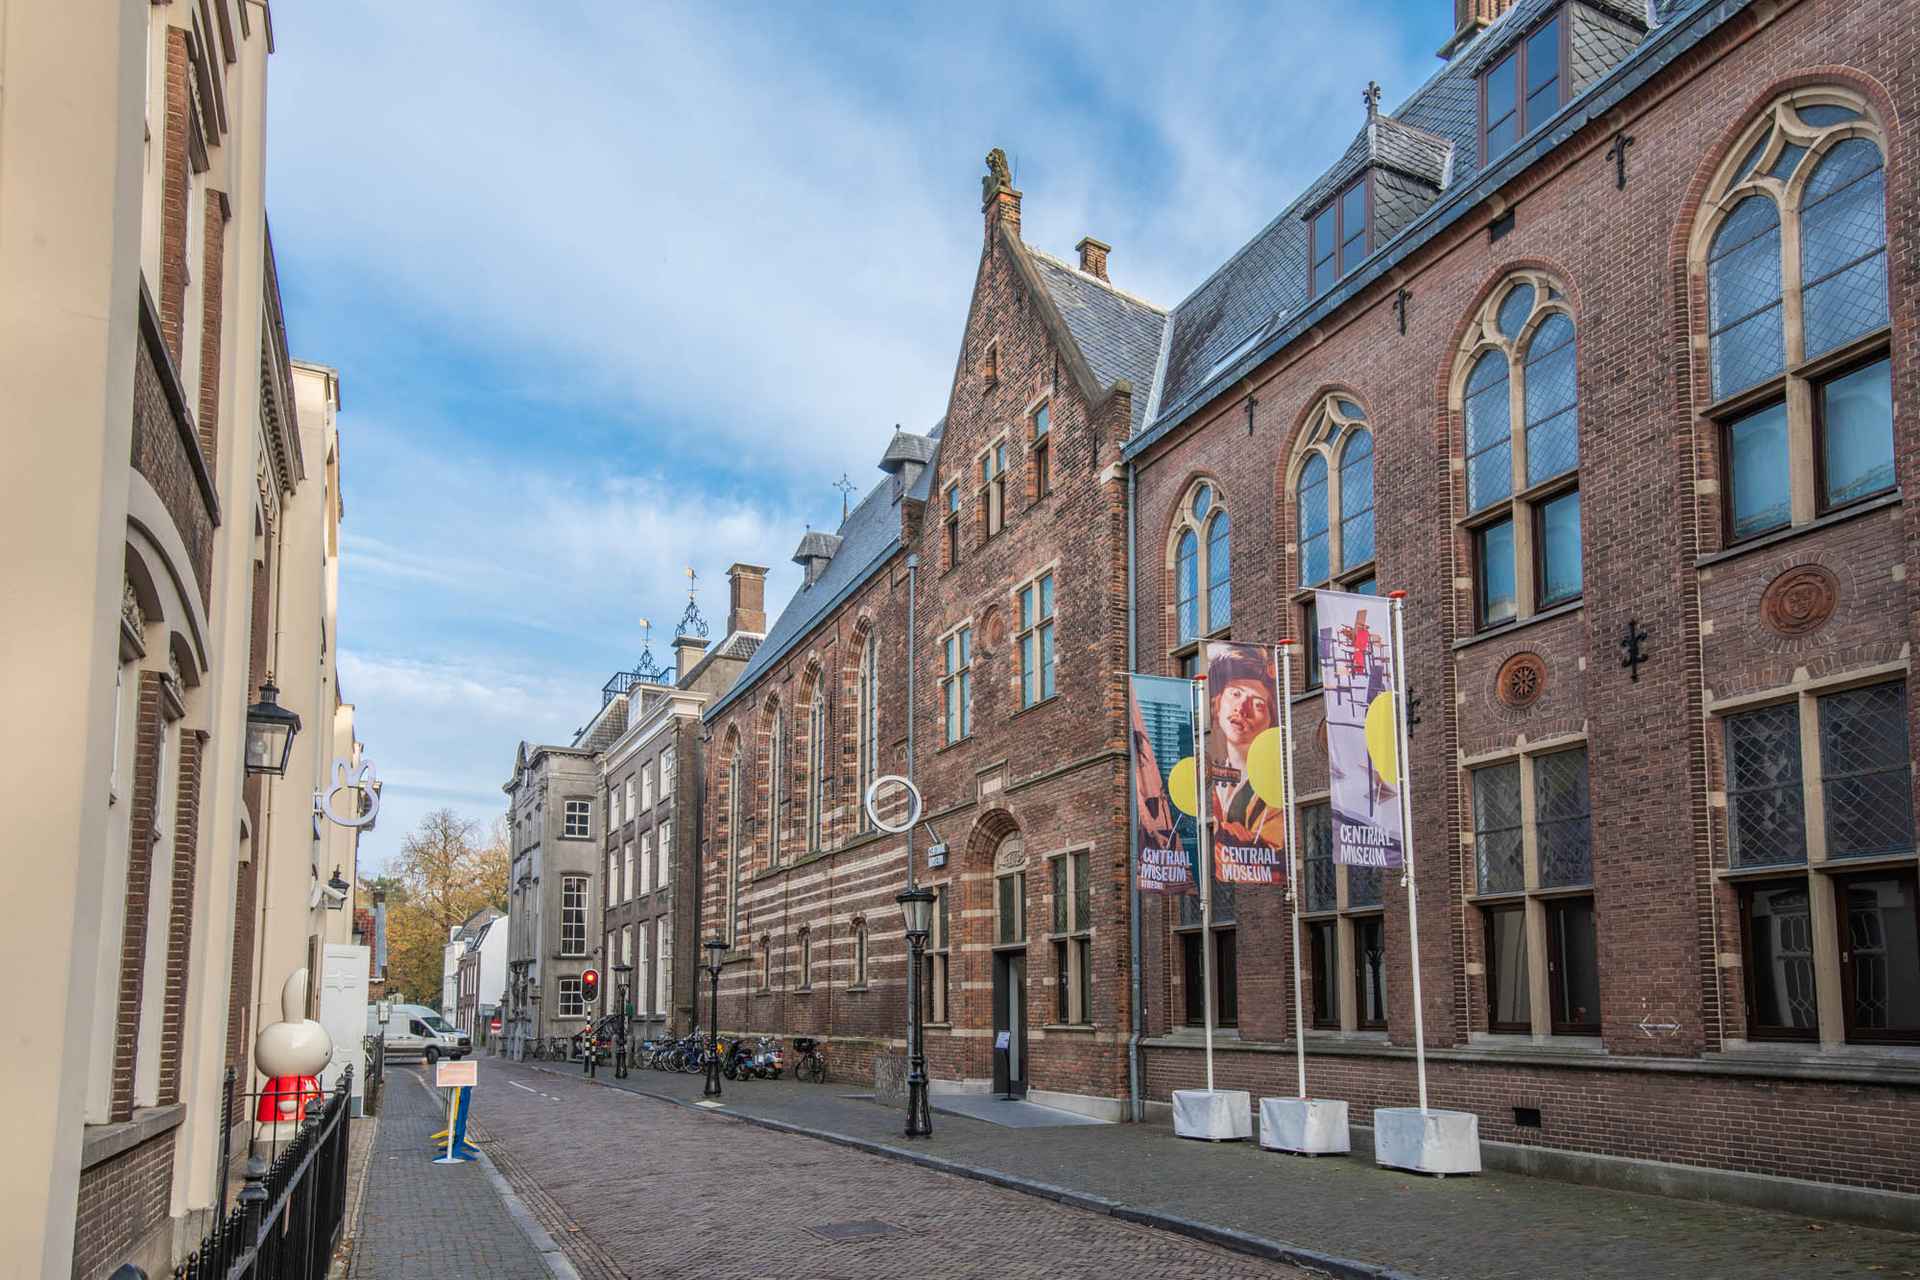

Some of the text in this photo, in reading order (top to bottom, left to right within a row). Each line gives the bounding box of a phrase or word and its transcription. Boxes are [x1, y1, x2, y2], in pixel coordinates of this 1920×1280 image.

[1340, 823, 1394, 846] CENTRAAL
[1142, 847, 1192, 866] CENTRAAL
[1220, 845, 1280, 864] CENTRAAL
[1340, 844, 1387, 866] MUSEUM
[1141, 863, 1186, 882] MUSEUM
[1221, 863, 1272, 883] MUSEUM
